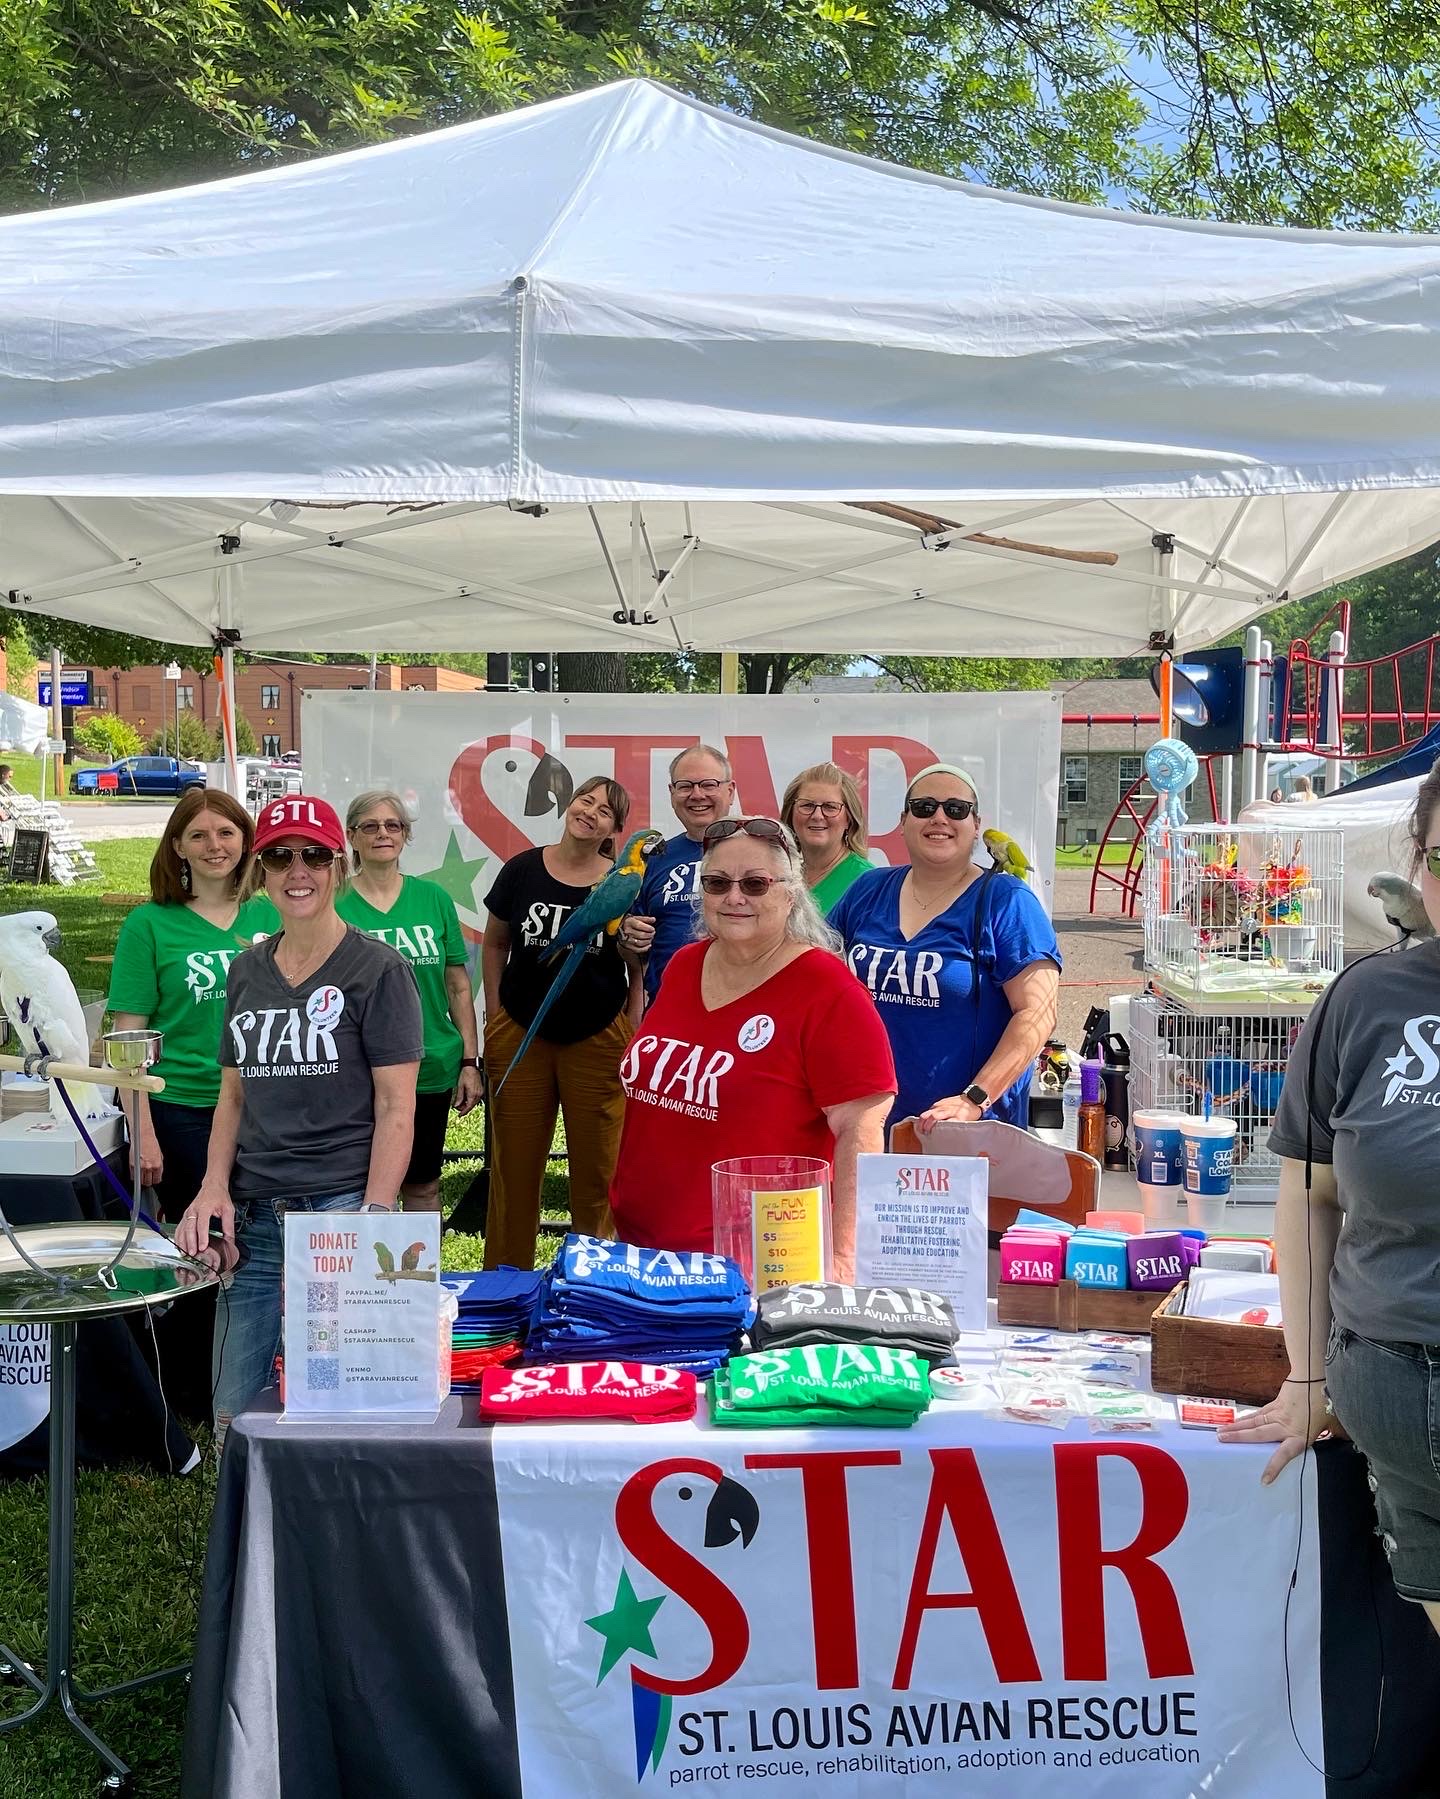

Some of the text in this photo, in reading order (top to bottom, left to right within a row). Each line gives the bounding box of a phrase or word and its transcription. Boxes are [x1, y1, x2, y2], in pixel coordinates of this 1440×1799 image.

[270, 800, 322, 828] STL
[416, 957, 440, 966] RESCUE
[879, 992, 904, 1004] AVIAN
[906, 996, 940, 1008] RESCUE
[229, 1008, 339, 1065] STAR
[247, 1066, 270, 1078] LOUIS
[272, 1065, 298, 1077] AVIAN
[300, 1062, 339, 1076] RESCUE
[620, 1035, 735, 1107] STAR
[635, 1089, 658, 1106] LOUIS
[658, 1096, 684, 1114] AVIAN
[685, 1104, 718, 1122] RESCUE
[1400, 1089, 1422, 1104] ST.
[1188, 1160, 1198, 1168] XL
[898, 1168, 949, 1191] STAR
[781, 1198, 804, 1208] FUN
[874, 1204, 886, 1212] OUR
[888, 1204, 912, 1212] MISSION
[921, 1205, 928, 1213] TO
[930, 1206, 955, 1214] IMPROVE
[956, 1206, 970, 1214] AND
[767, 1209, 806, 1221] FUNDS
[878, 1214, 966, 1226] ENRICH THE LIVES OF PARROTS
[763, 1232, 777, 1242] $5
[896, 1225, 948, 1236] THROUGH RESCUE,
[310, 1232, 358, 1250] DONATE
[880, 1235, 962, 1247] REHABILITATIVE FOSTERING,
[579, 1234, 727, 1276] STAR
[768, 1248, 788, 1257] $10
[882, 1246, 960, 1258] ADOPTION AND EDUCATION.
[314, 1256, 354, 1273] TODAY
[764, 1264, 784, 1274] $25
[1011, 1260, 1054, 1278] STAR
[1075, 1262, 1118, 1281] STAR
[1136, 1256, 1182, 1277] STAR
[589, 1261, 727, 1288] ST. LOUIS AVIAN RESCUE
[787, 1282, 950, 1320] STAR
[804, 1306, 952, 1327] ST. LOUIS AVIAN RESCUE
[748, 1345, 921, 1380] STAR
[0, 1364, 52, 1385] ESCUE
[512, 1362, 679, 1391] STAR
[771, 1374, 922, 1392] ST. LOUIS AVIAN RESCUE
[526, 1390, 544, 1398] ST.
[548, 1386, 587, 1396] LOUIS
[591, 1386, 630, 1398] AVIAN
[615, 1442, 1195, 1696] STAR
[678, 1692, 1198, 1755] ST. LOUIS AVIAN RESCUE
[669, 1743, 1200, 1787] parrot rescue, rehabilitation, adoption and education
